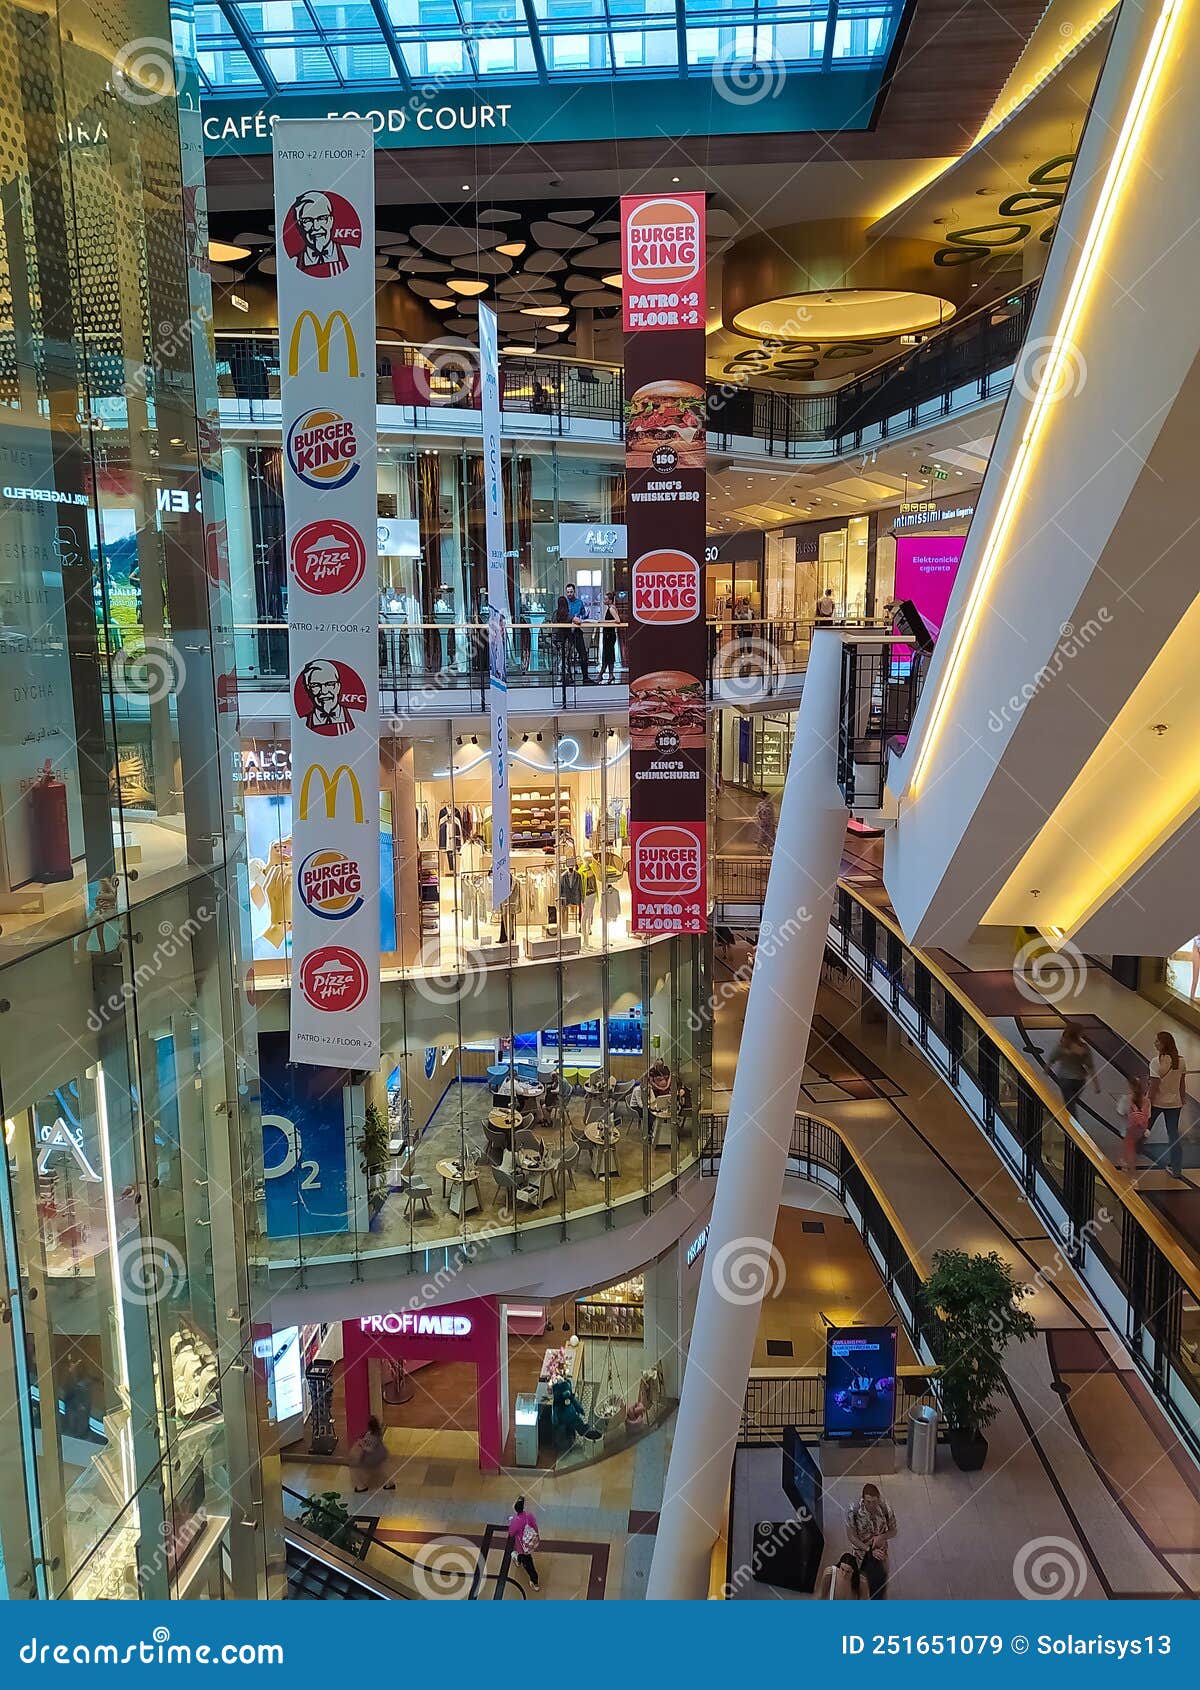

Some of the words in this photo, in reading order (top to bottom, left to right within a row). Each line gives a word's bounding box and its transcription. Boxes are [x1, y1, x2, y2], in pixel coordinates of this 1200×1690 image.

[416, 105, 511, 130] COURT
[278, 150, 304, 159] PATRO
[307, 150, 317, 159] +2
[324, 150, 353, 159] FLOOR
[355, 150, 366, 159] +2
[334, 228, 360, 238] KFC
[631, 226, 695, 243] BURGER
[631, 242, 695, 266] KING
[629, 293, 678, 308] PATRO
[681, 292, 698, 307] +2
[629, 311, 678, 326] FLOOR
[681, 310, 698, 325] +2
[294, 422, 353, 452] BURGER
[297, 436, 357, 474] KING
[656, 455, 675, 464] 150
[647, 481, 682, 490] KING'S
[631, 492, 677, 502] WHISKEY
[679, 491, 700, 502] BBQ
[306, 551, 350, 573] Pizza
[313, 563, 346, 582] Hut
[636, 574, 696, 588] BURGER
[636, 588, 696, 608] KING
[290, 623, 312, 631] PATRO
[315, 624, 325, 632] +2
[332, 624, 358, 633] FLOOR
[361, 625, 370, 633] +2
[341, 694, 366, 703] KFC
[659, 737, 676, 746] 150
[650, 761, 683, 770] KING'S
[635, 771, 700, 780] CHIMICHURRI
[639, 849, 697, 861] BURGER
[304, 862, 358, 885] BURGER
[639, 862, 697, 880] KING
[307, 874, 361, 904] KING
[637, 904, 682, 915] PATRO
[684, 904, 700, 915] +2
[638, 918, 682, 930] FLOOR
[684, 918, 700, 930] +2
[313, 972, 354, 992] Pizza
[320, 984, 350, 999] Hut
[297, 1034, 319, 1043] PATRO
[322, 1036, 331, 1044] +2
[337, 1037, 361, 1046] FLOOR
[363, 1040, 372, 1048] +2
[361, 1313, 472, 1335] PROFIMED
